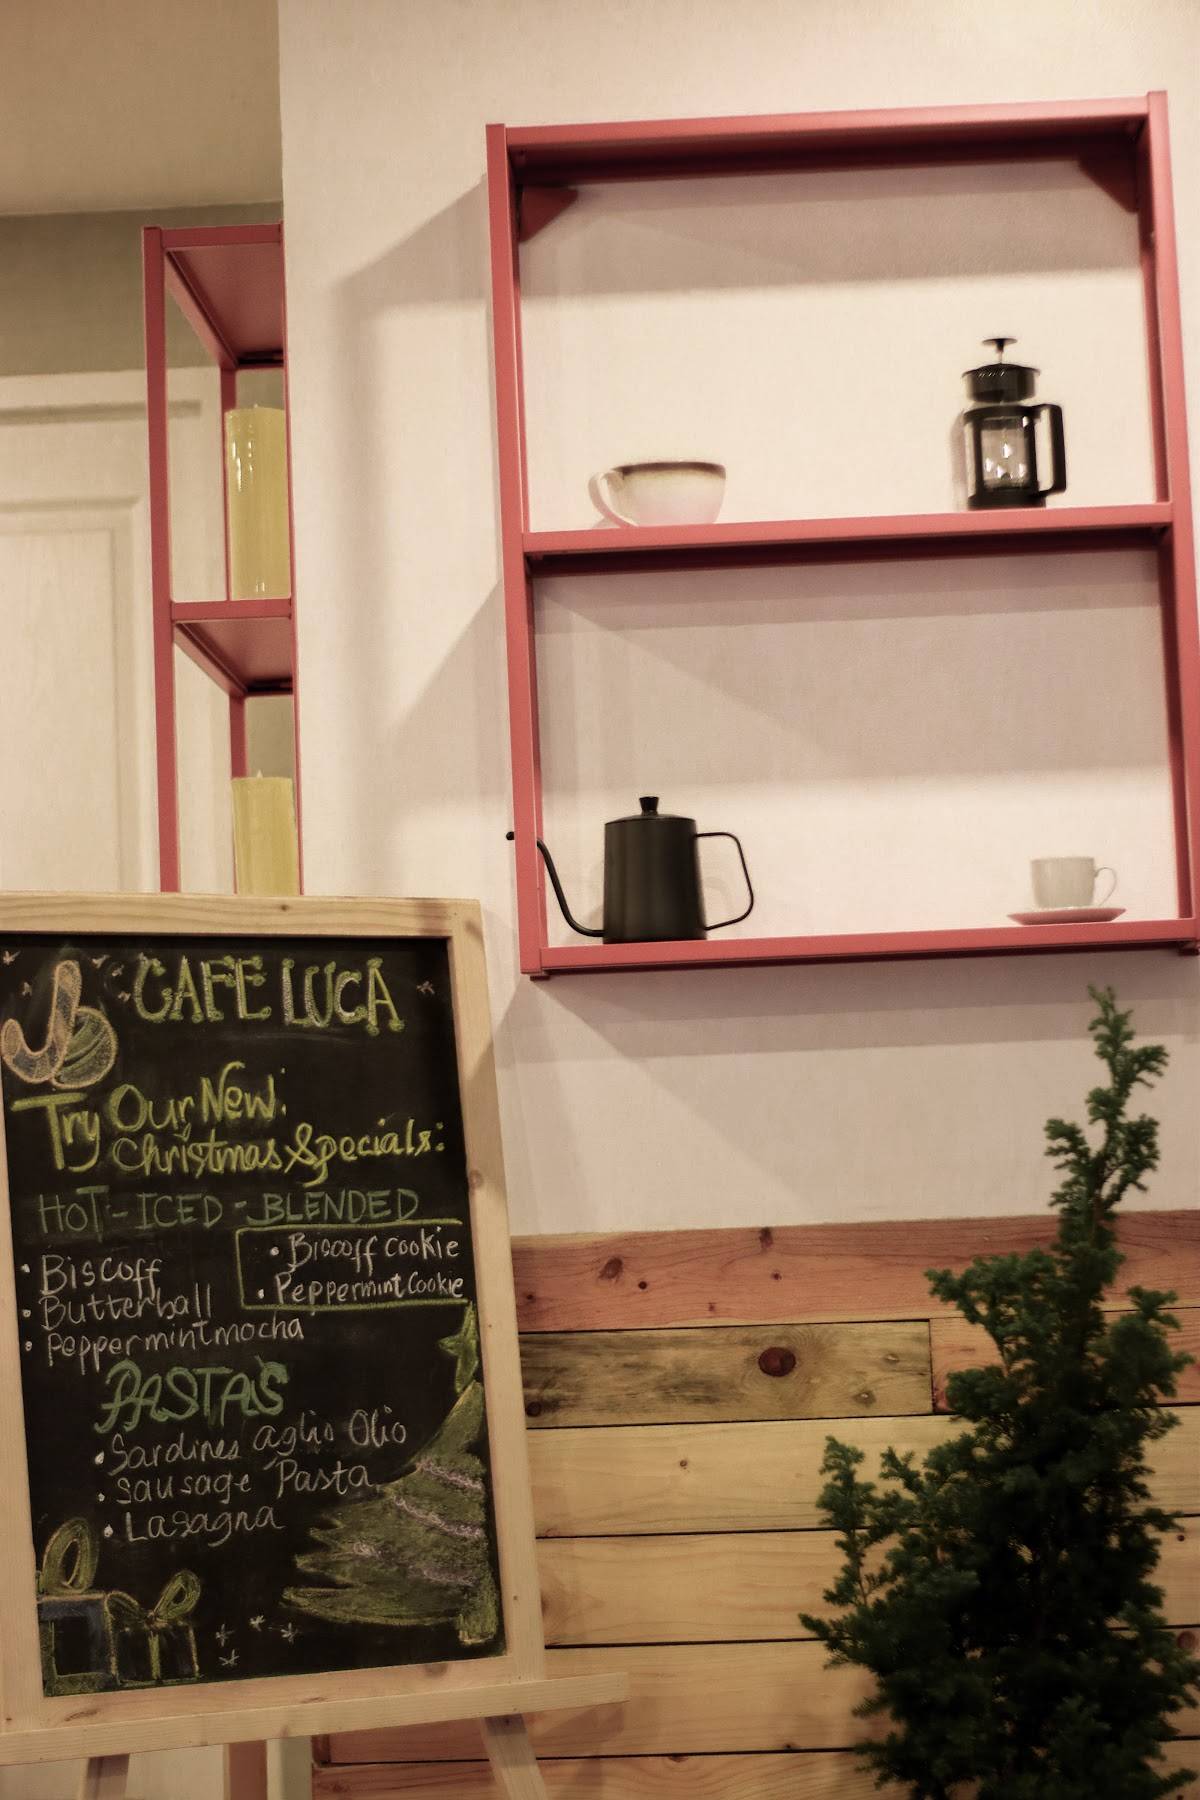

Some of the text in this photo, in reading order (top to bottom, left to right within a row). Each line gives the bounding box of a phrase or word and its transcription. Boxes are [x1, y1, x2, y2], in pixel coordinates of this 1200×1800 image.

[133, 954, 405, 1035] CAFE LUCA
[10, 1092, 100, 1172] Try
[108, 1083, 196, 1132] Our
[112, 1124, 282, 1178] Christmas
[39, 1185, 419, 1243] HOT ICED BLENDED
[41, 1253, 163, 1302] Biscoff
[288, 1232, 378, 1277] Biscoff
[39, 1283, 213, 1334] Butterball
[274, 1271, 404, 1305] Peppermint
[94, 1354, 290, 1434] PASTAS
